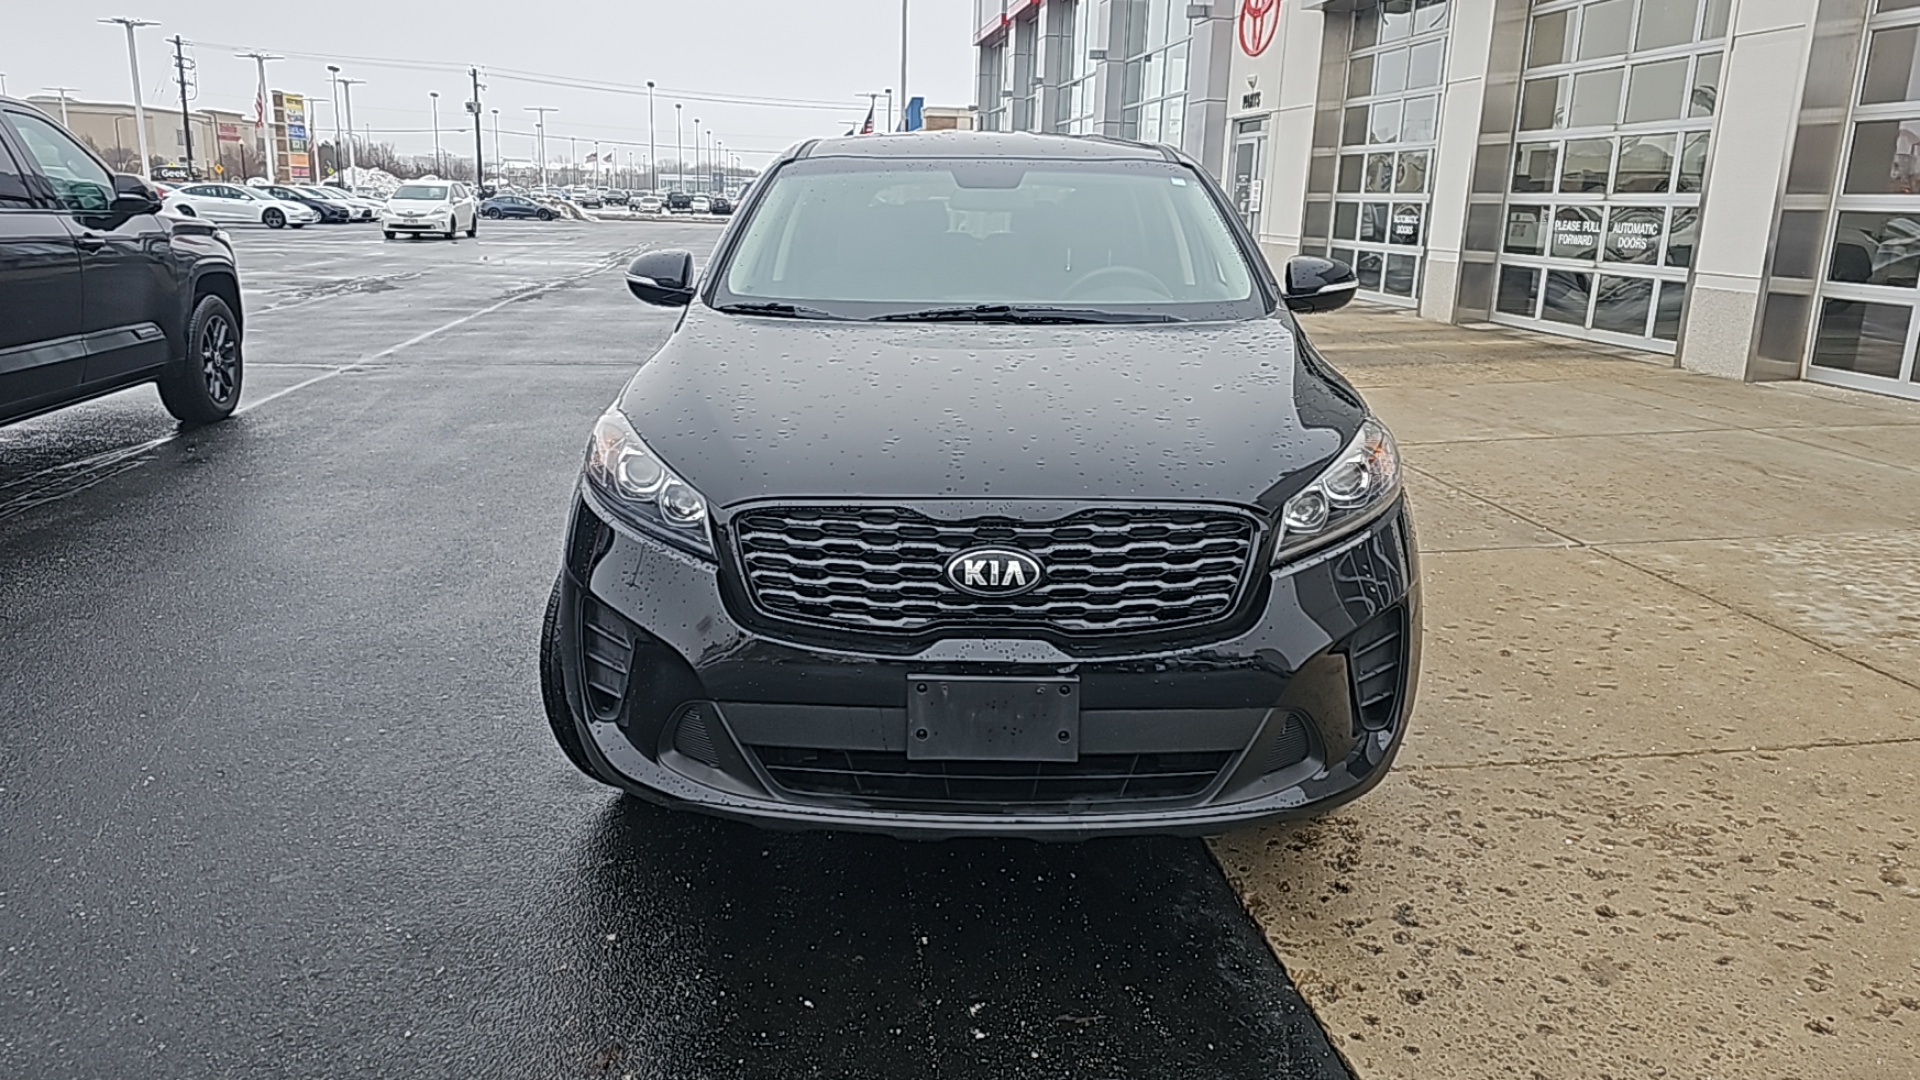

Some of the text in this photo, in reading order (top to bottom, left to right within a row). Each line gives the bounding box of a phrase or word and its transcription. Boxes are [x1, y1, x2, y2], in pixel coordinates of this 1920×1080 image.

[1554, 220, 1601, 232] PLEASE PULL
[1612, 222, 1658, 235] AUTOMATIC
[1558, 233, 1593, 246] FORWARD
[1617, 236, 1647, 249] DOORS
[964, 560, 1026, 586] KIA
